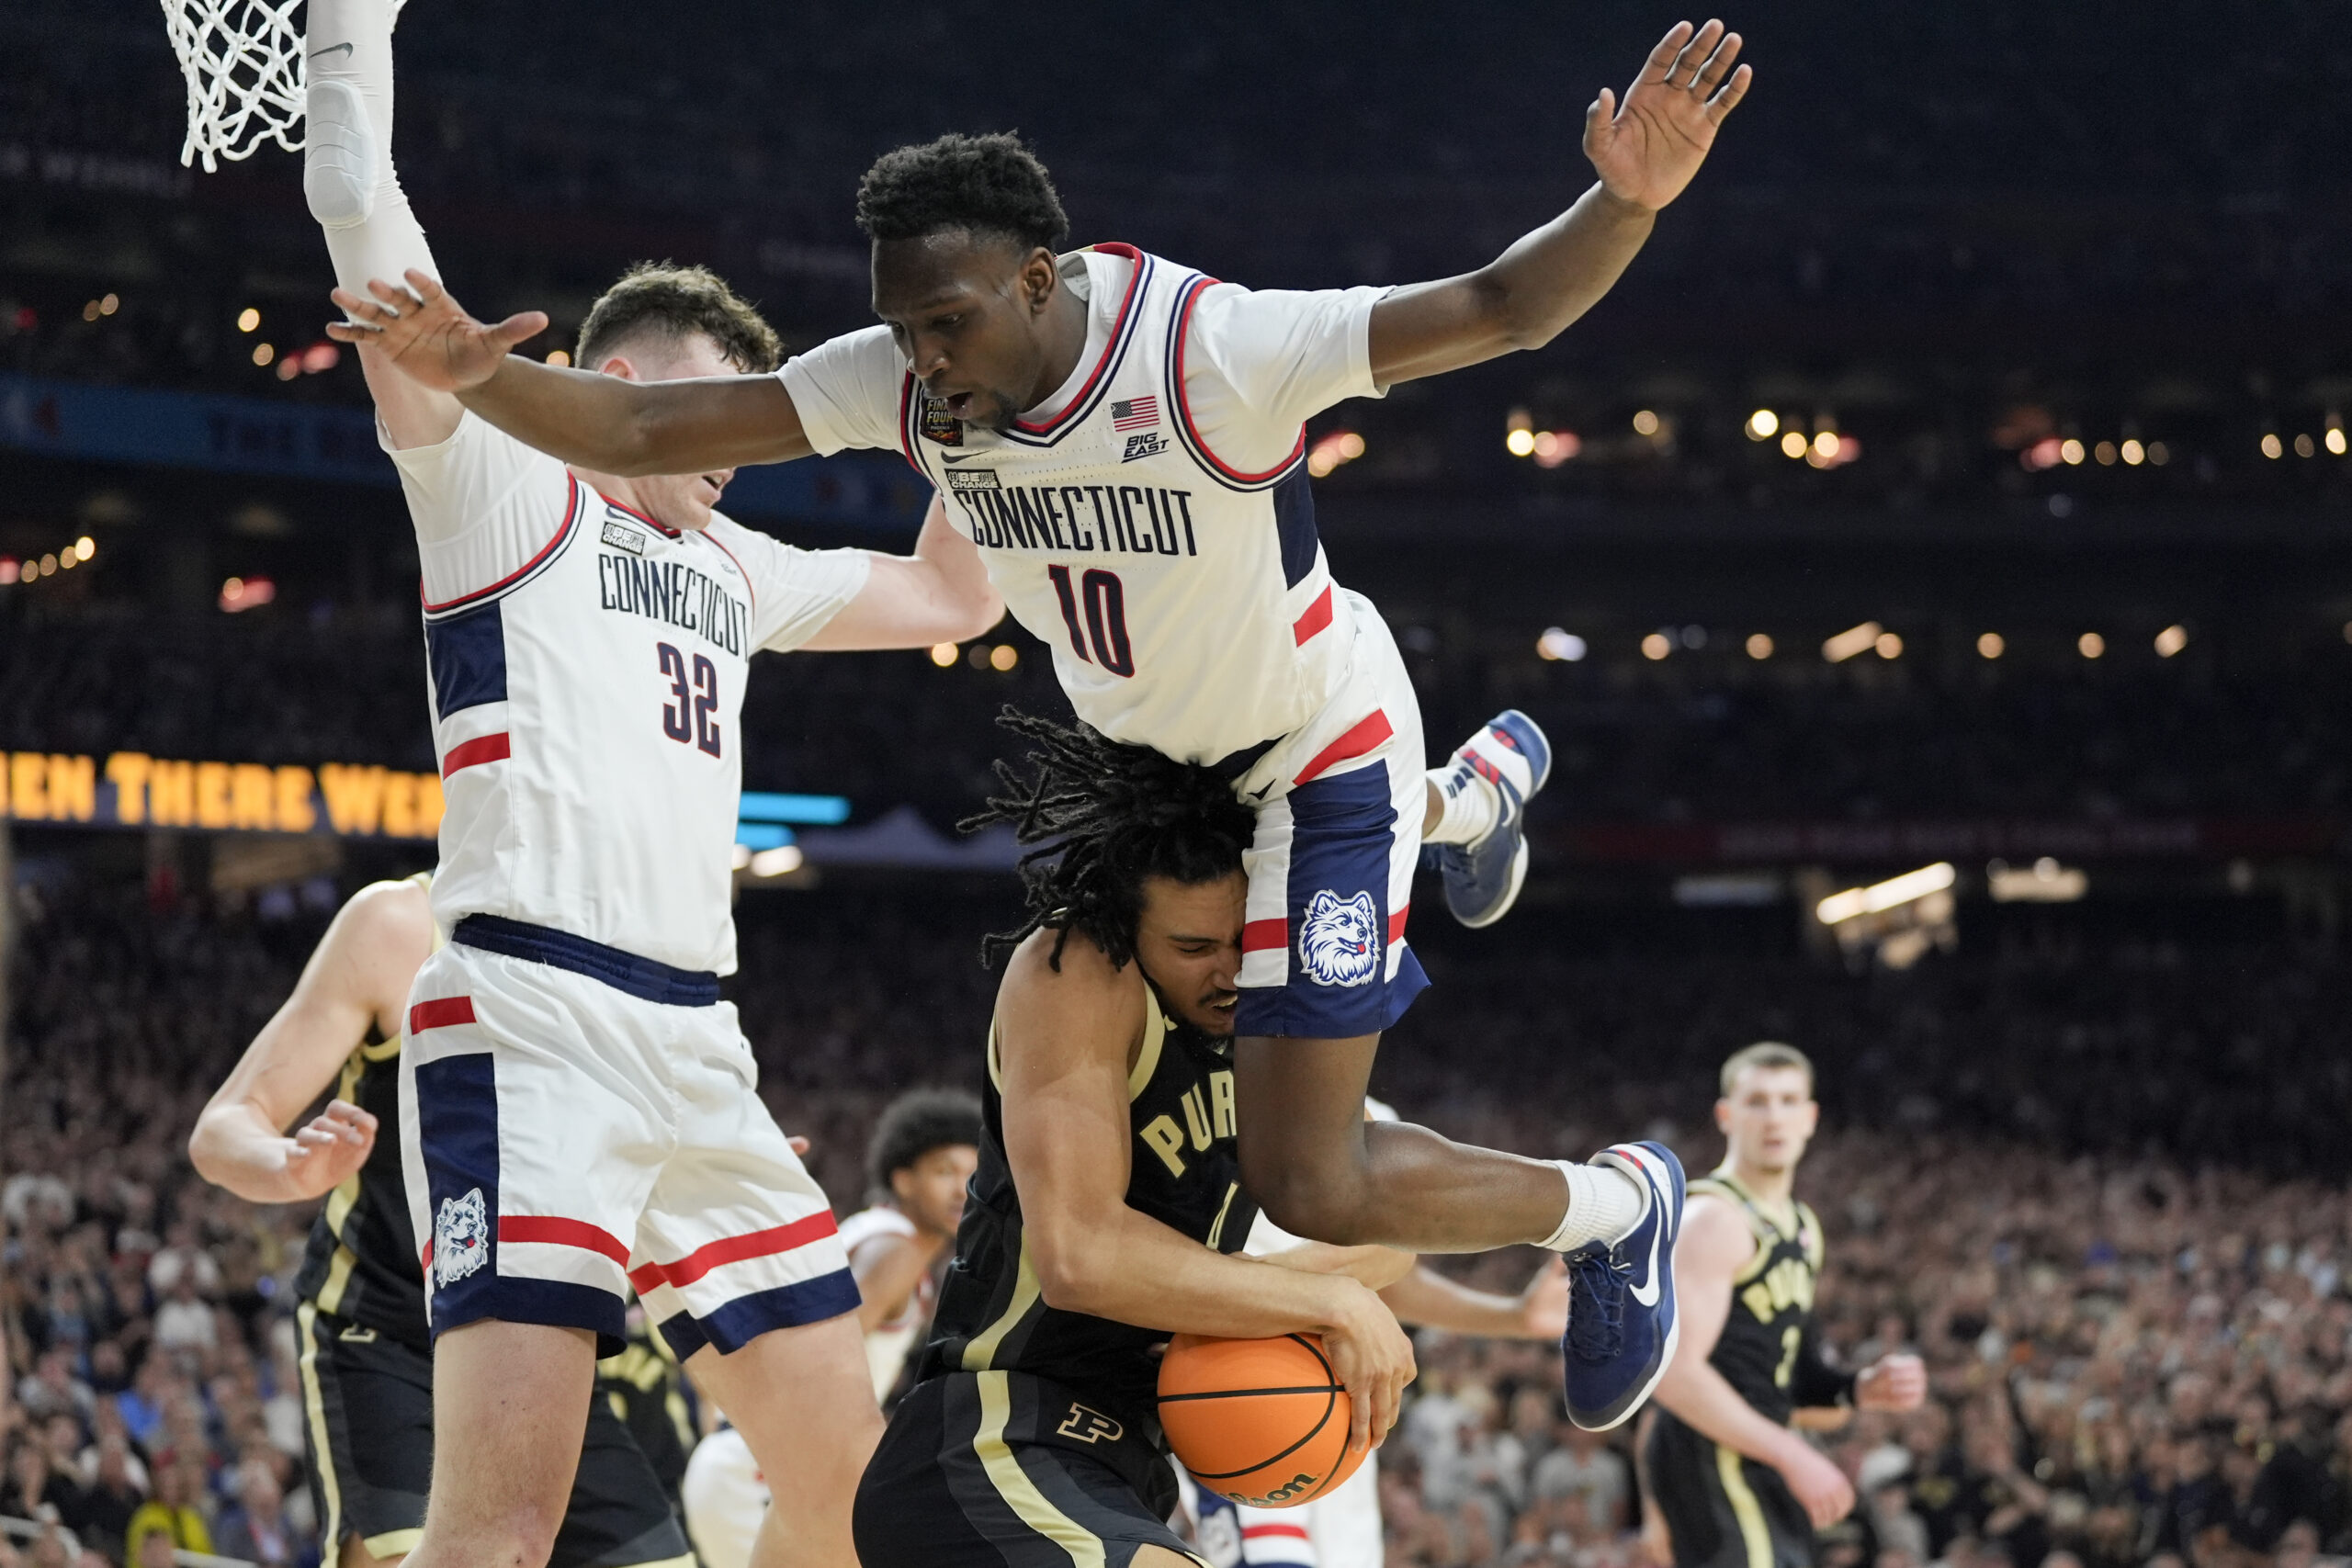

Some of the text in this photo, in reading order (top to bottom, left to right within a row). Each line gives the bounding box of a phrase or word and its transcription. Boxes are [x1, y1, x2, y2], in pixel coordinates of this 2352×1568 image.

[1124, 439, 1170, 458] EAST
[1126, 432, 1158, 447] BIG
[952, 485, 1198, 557] CONNECTICUT
[597, 552, 750, 664] CONNECTICUT
[1046, 563, 1136, 679] 10
[656, 641, 721, 760] 32
[0, 750, 96, 823] EN
[105, 750, 318, 834] THERE
[1056, 1401, 1124, 1444] P
